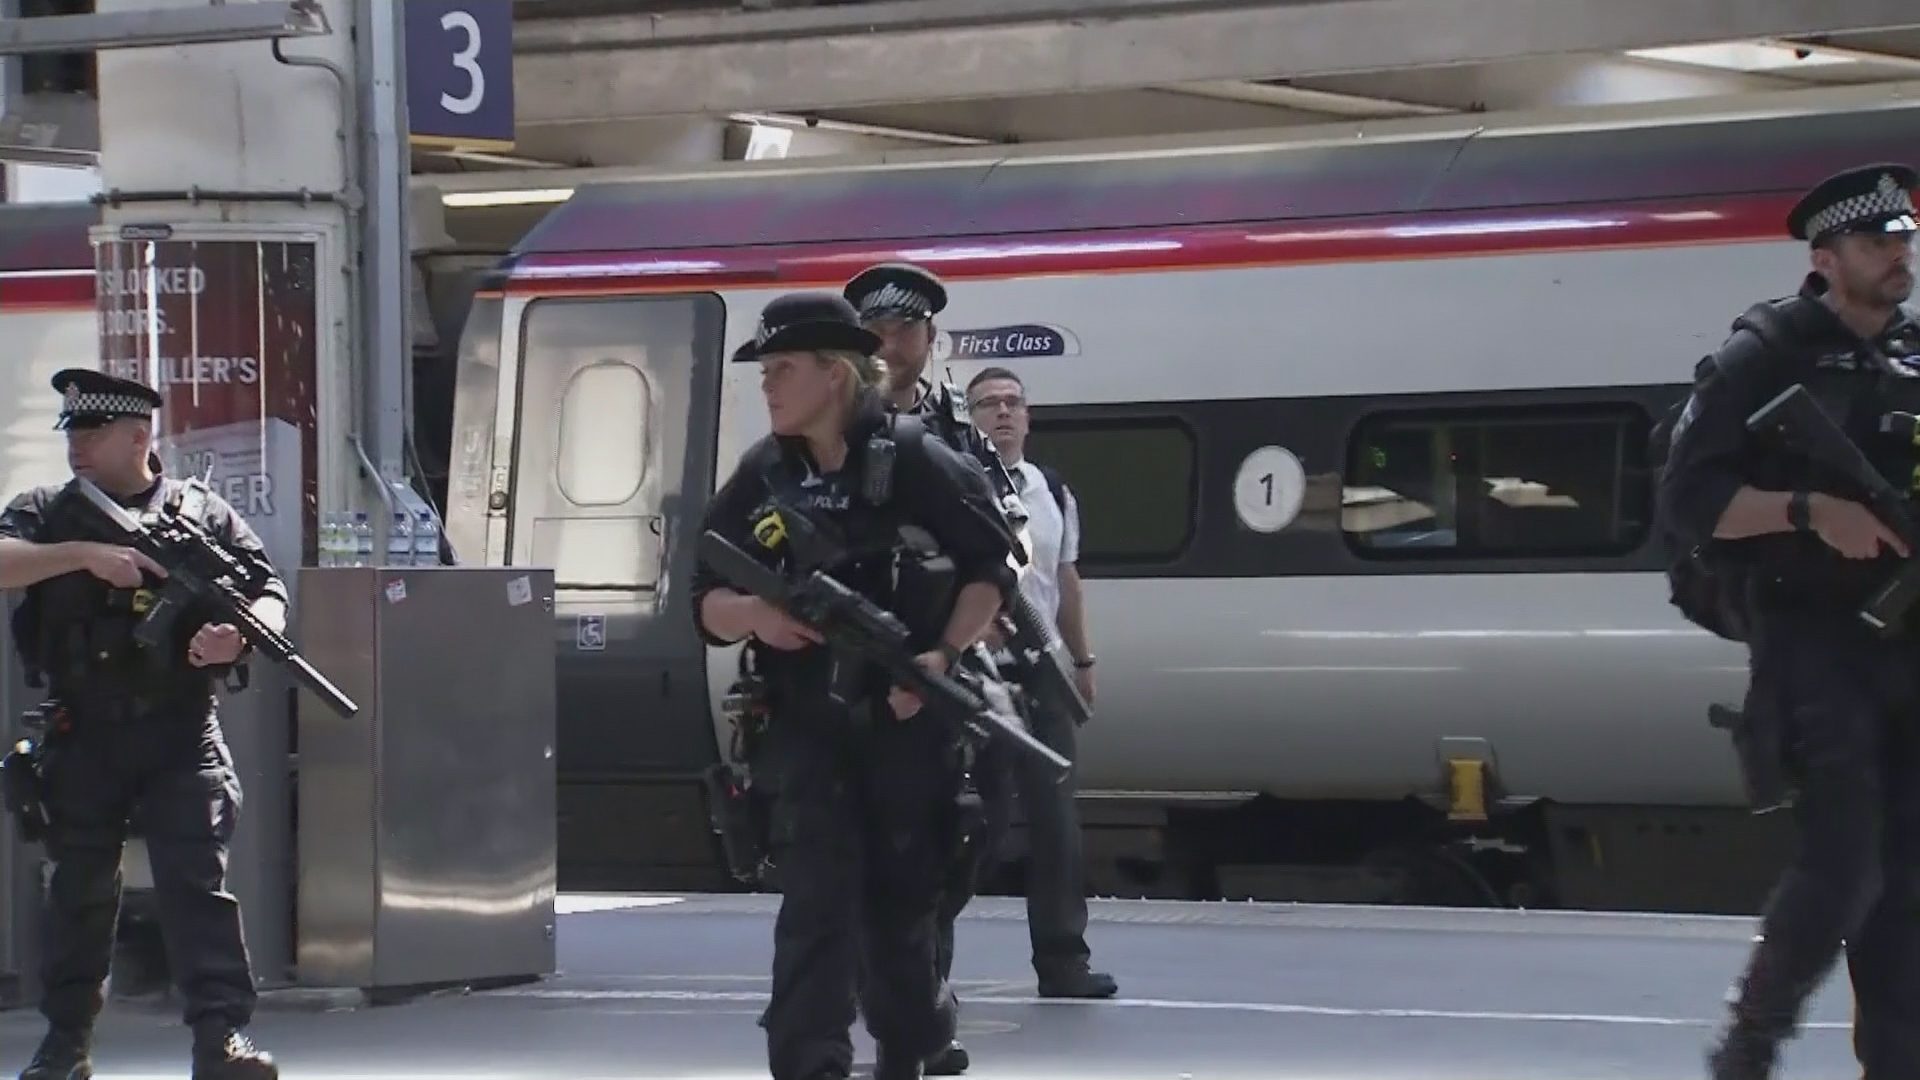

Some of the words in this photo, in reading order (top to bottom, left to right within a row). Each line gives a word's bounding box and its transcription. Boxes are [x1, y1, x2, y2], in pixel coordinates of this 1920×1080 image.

[440, 10, 485, 114] 3
[117, 267, 206, 295] LOCKED
[958, 335, 1000, 354] First
[1005, 332, 1052, 352] Class
[1259, 473, 1273, 506] 1
